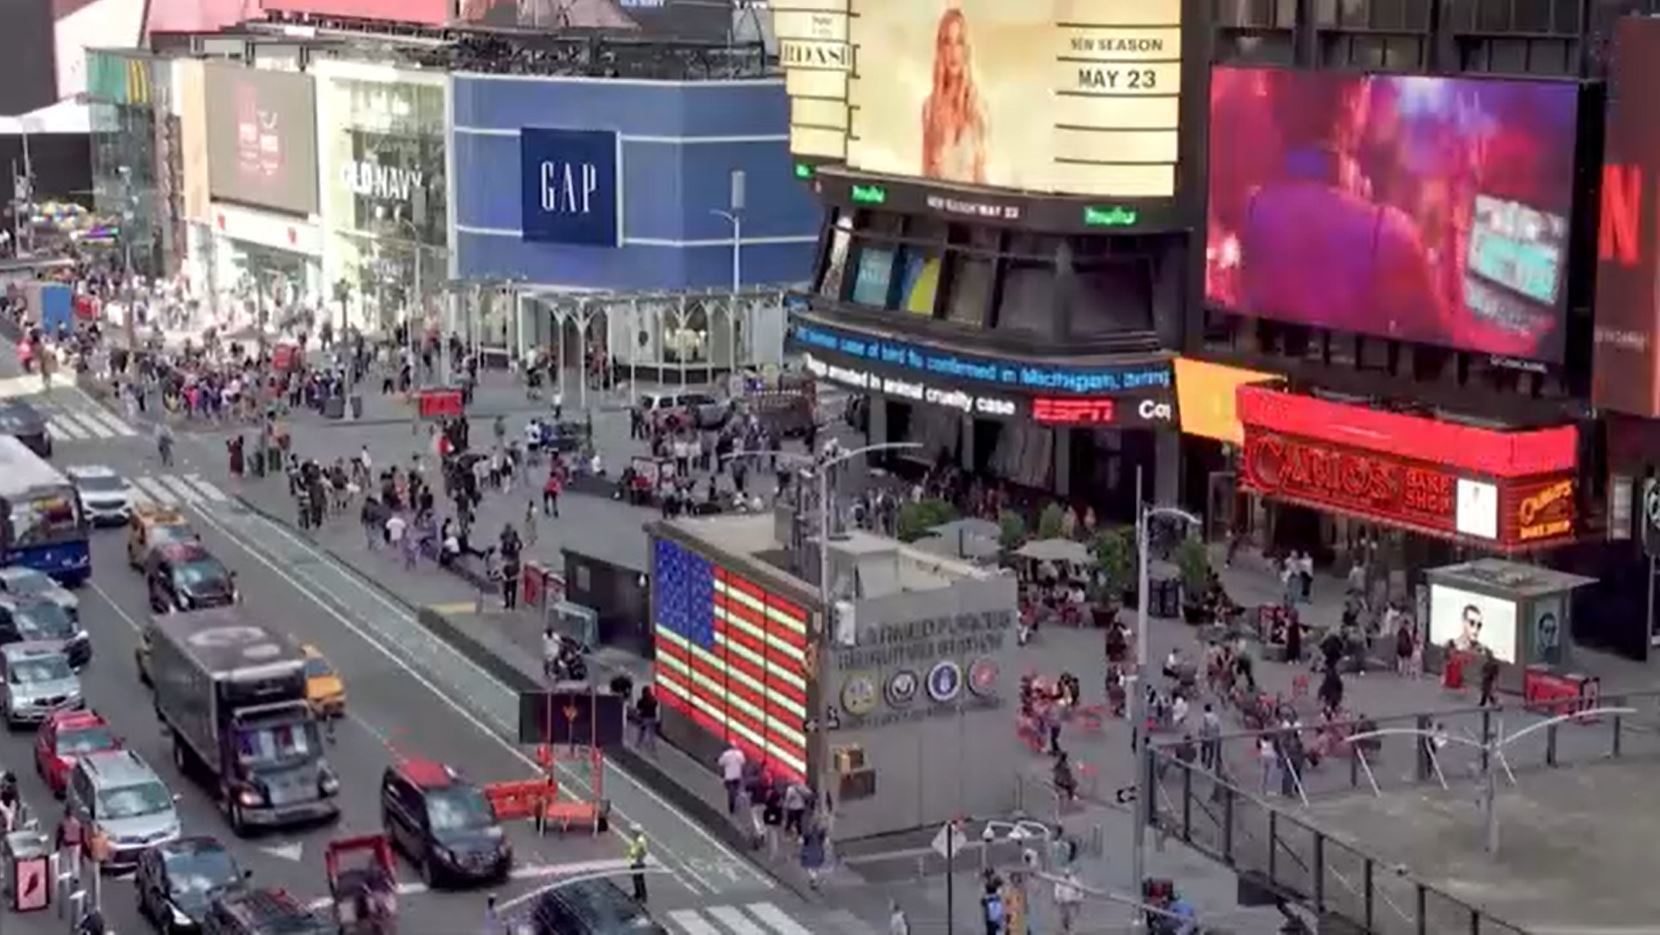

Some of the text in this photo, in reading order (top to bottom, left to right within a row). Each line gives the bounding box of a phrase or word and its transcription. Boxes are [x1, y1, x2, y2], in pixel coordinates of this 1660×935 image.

[1098, 38, 1163, 52] SEASON
[1078, 68, 1157, 89] MAY 23
[540, 160, 597, 213] GAP
[1600, 165, 1641, 268] N
[925, 387, 973, 413] cruelty
[976, 396, 1016, 416] case
[1033, 398, 1114, 422] ESPN
